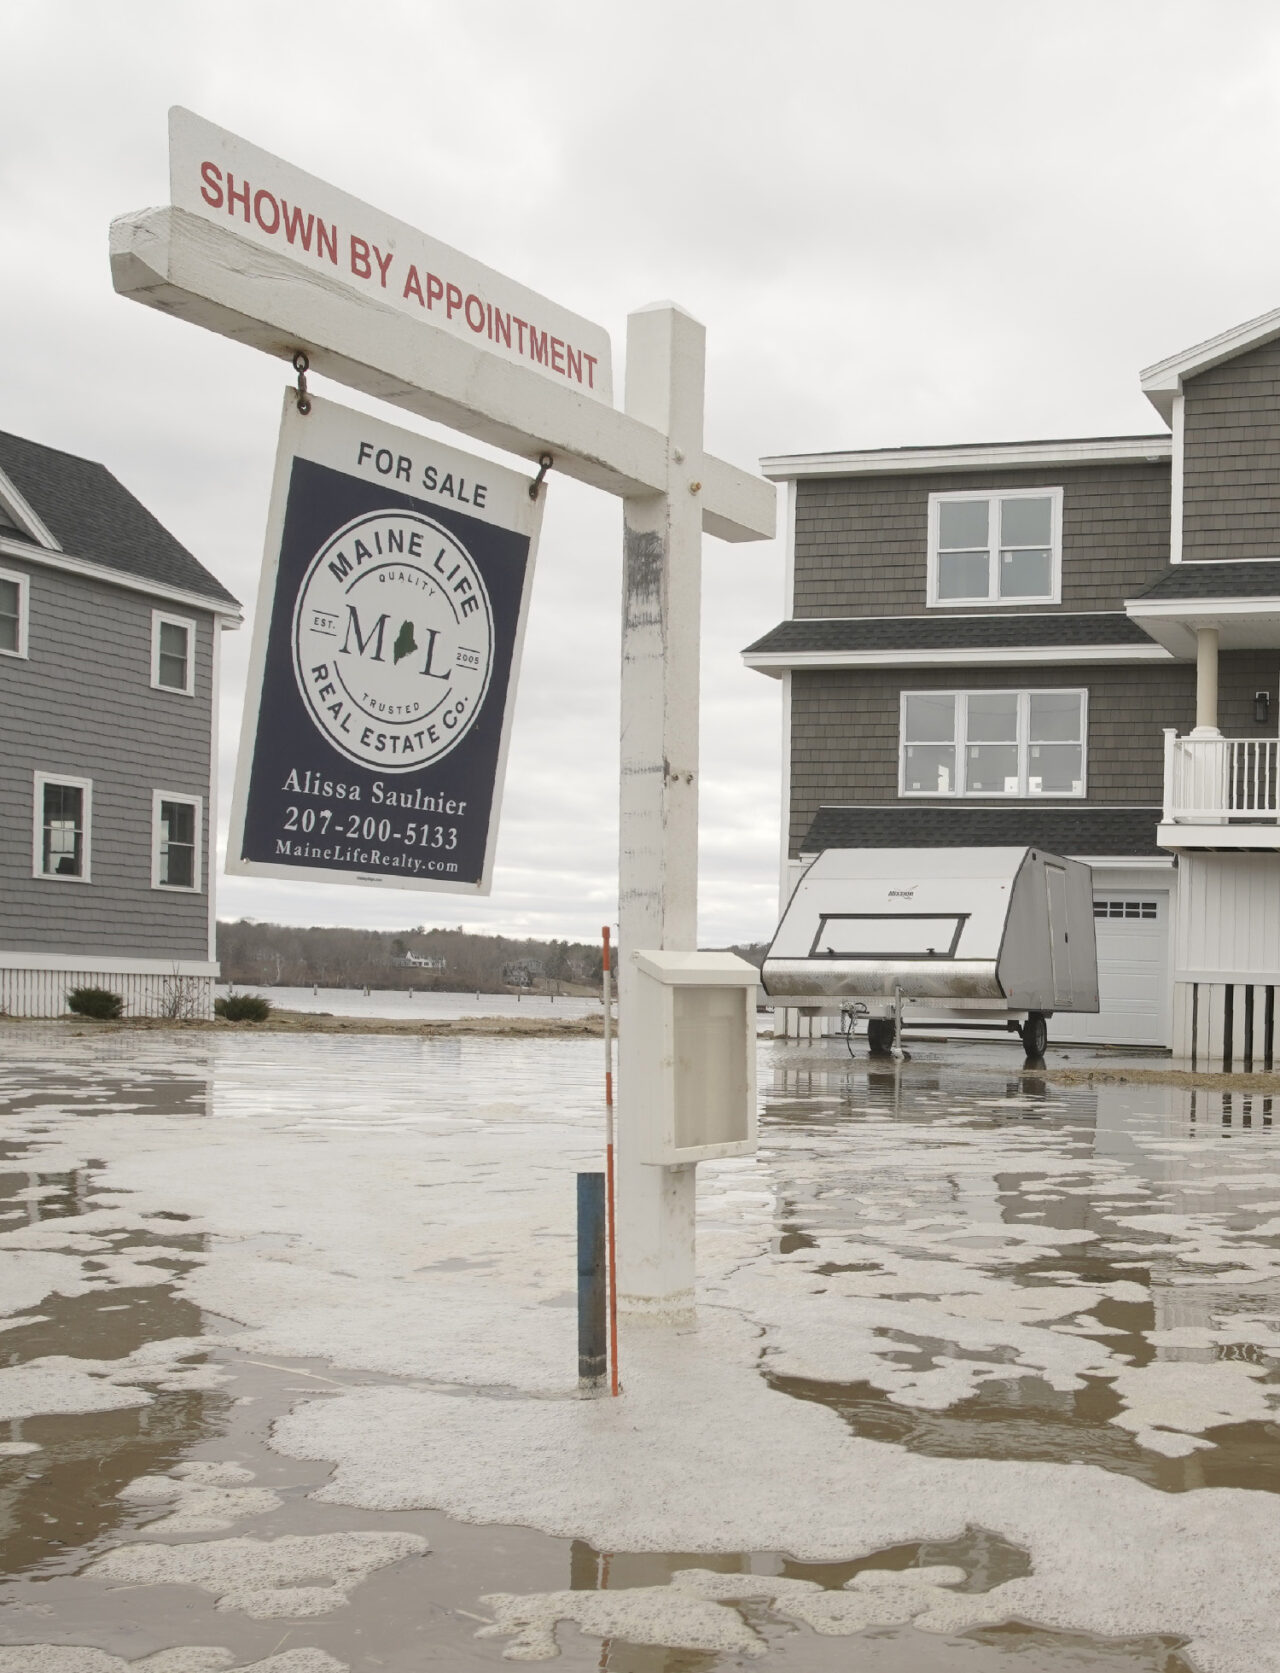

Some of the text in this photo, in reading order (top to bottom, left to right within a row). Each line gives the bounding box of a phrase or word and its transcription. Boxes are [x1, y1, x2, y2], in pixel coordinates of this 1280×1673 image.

[200, 161, 598, 389] SHOWN BY APPOINTMENT
[357, 441, 488, 509] FOR SALE
[328, 528, 480, 618] MAINE LIFE
[379, 571, 436, 598] QUALITY
[313, 616, 336, 630] EST.
[338, 604, 453, 681] M L
[456, 652, 480, 665] 2005
[311, 663, 353, 734] REAL
[360, 727, 440, 754] ESTATE
[362, 693, 420, 715] TRUSTED
[281, 768, 467, 816] Alissa Saulnier
[283, 806, 458, 850] 207-200-5133
[275, 838, 458, 873] MaineLifeRealty.com
